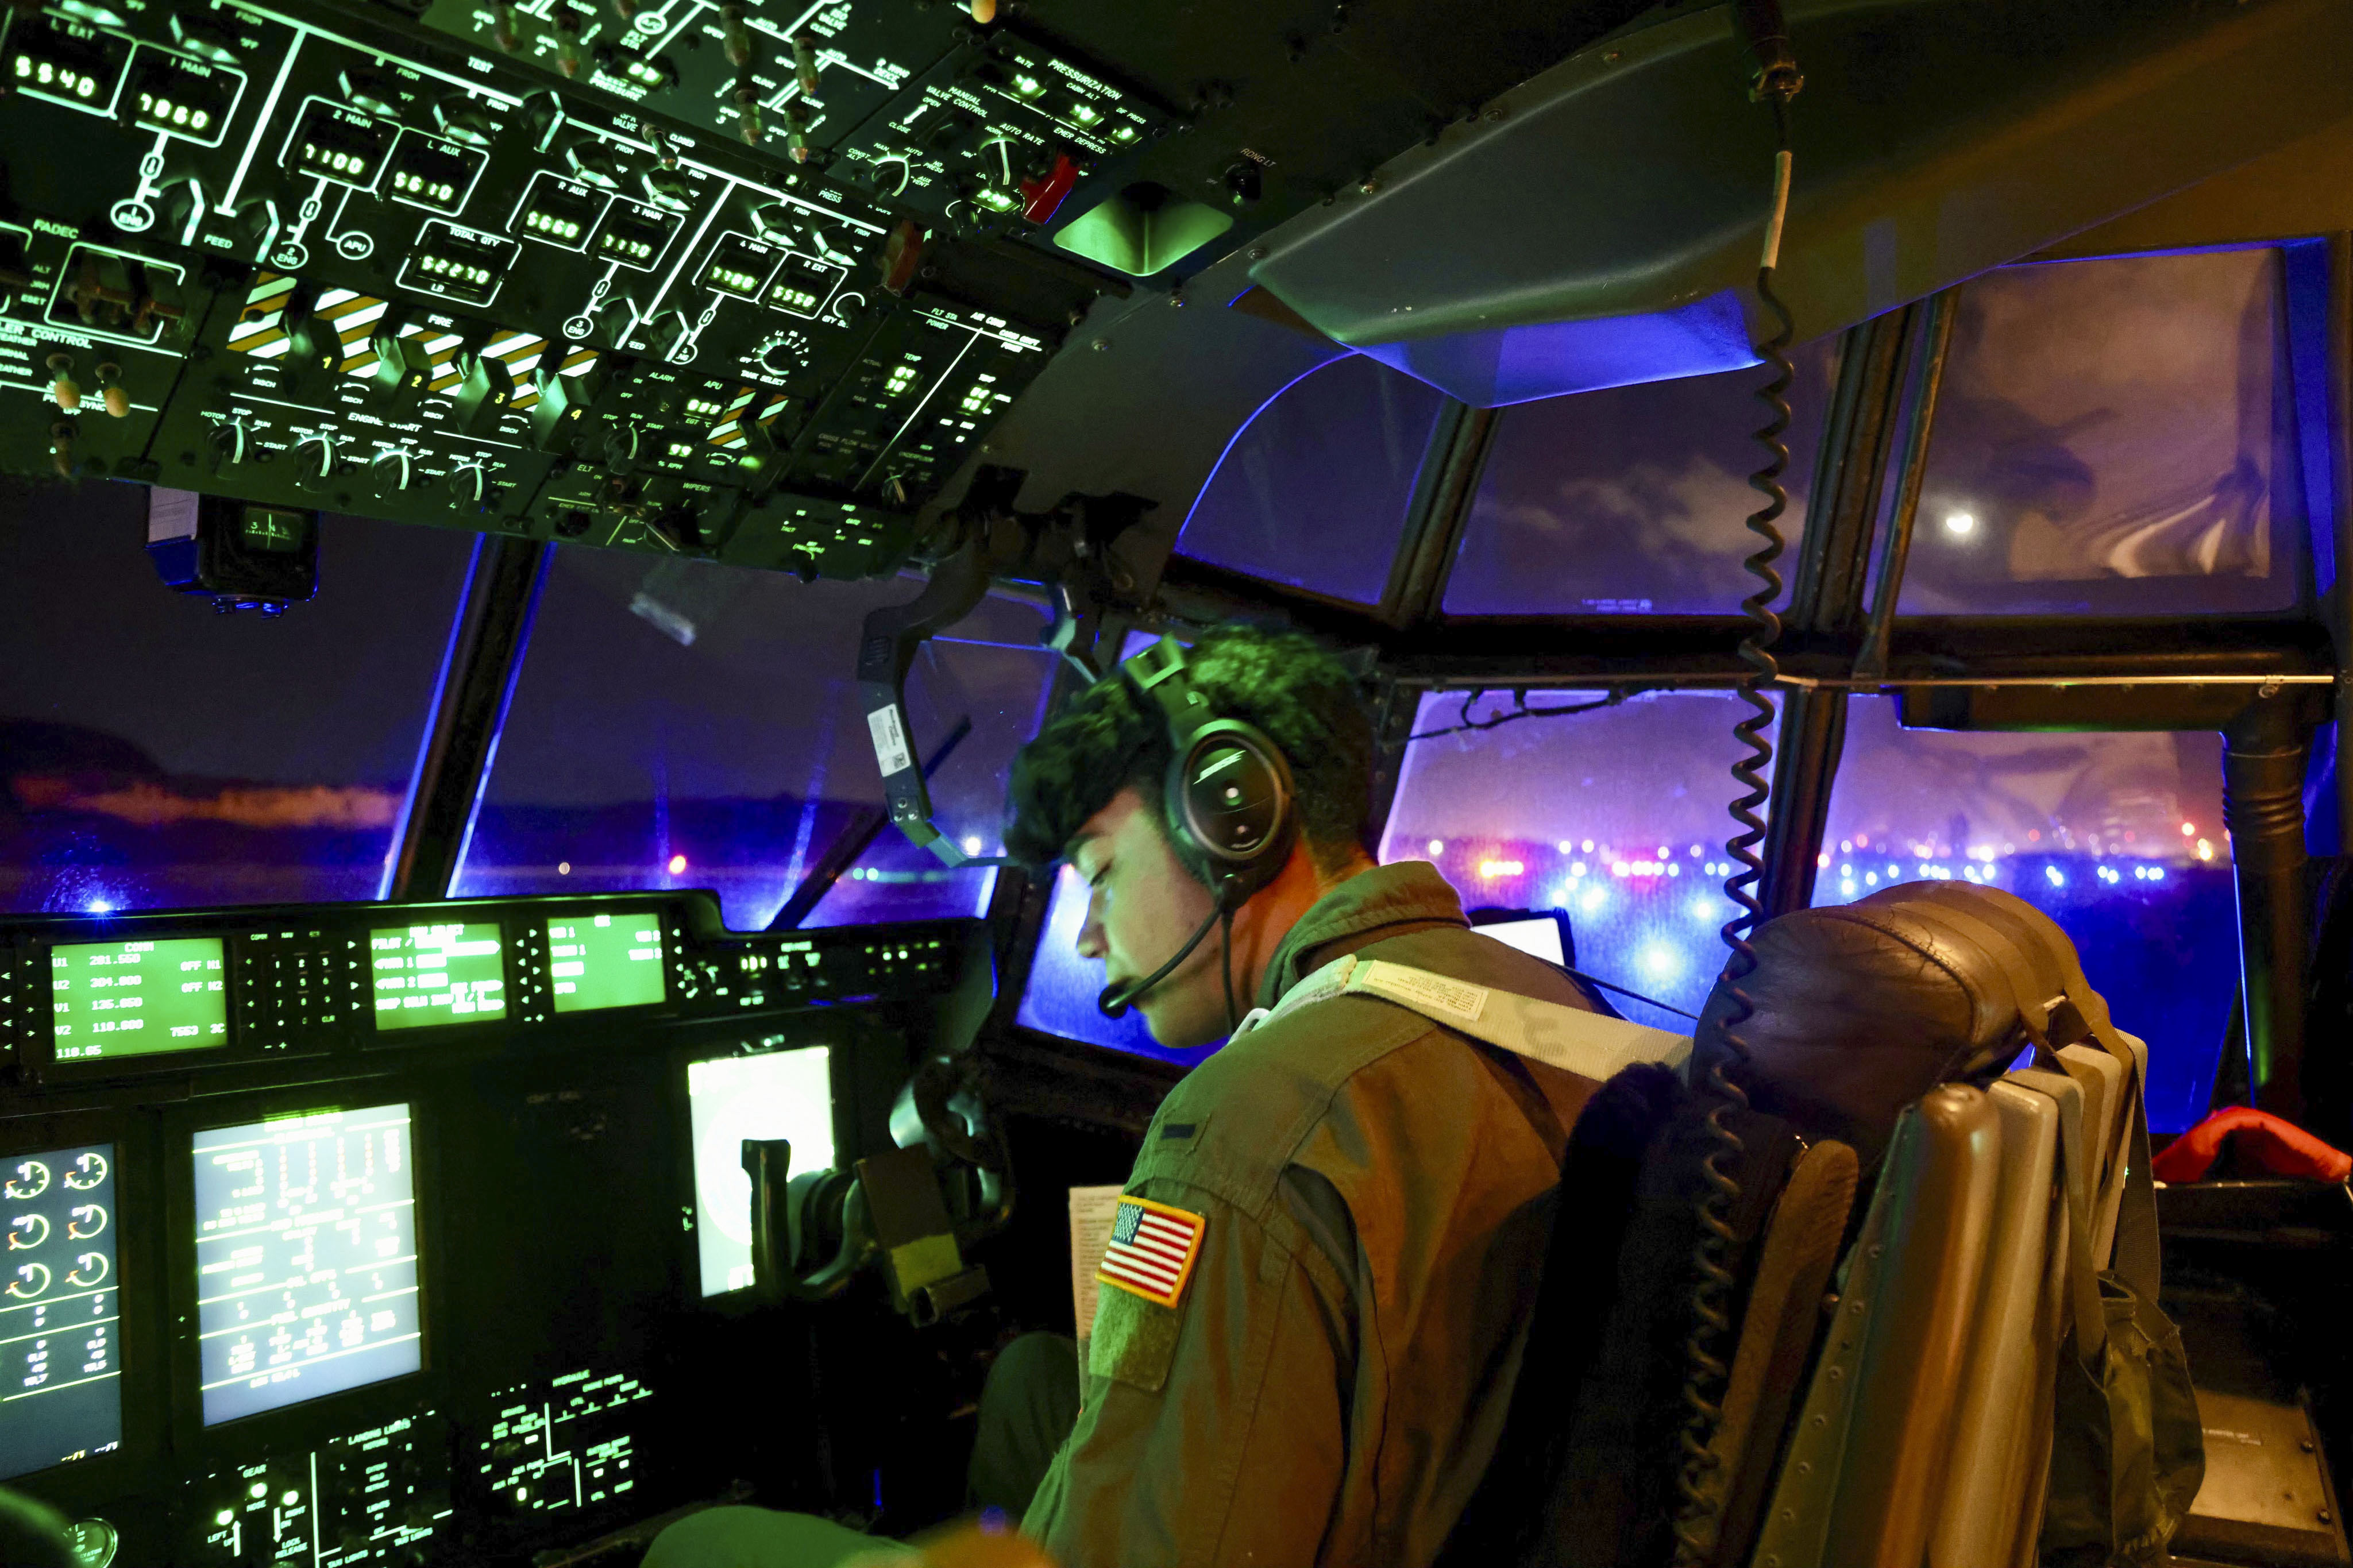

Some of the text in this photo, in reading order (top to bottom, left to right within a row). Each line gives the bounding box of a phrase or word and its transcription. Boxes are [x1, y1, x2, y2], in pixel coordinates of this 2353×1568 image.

[468, 56, 493, 73] TEST
[1015, 56, 1034, 68] RATE
[181, 60, 211, 78] MAIN
[396, 68, 420, 82] FROM
[1048, 59, 1123, 101] PRESSURIZATION
[948, 86, 981, 106] MANUAL
[1066, 82, 1101, 101] CABIN ALT
[487, 99, 510, 112] FROM
[923, 96, 942, 108] OPEN
[926, 85, 988, 118] VALVE CONTROL
[333, 110, 372, 129] 2 MAIN
[612, 117, 638, 132] VALVE
[1127, 113, 1147, 125] PRESS
[889, 121, 911, 134] CLOSE
[985, 126, 1003, 136] NORM
[999, 123, 1046, 146] AUTO RATE
[669, 134, 695, 148] CLOSED
[1054, 128, 1075, 140] EMER
[1074, 137, 1106, 154] DEPRESS
[427, 140, 461, 157] L AUX
[615, 144, 635, 155] FROM
[873, 142, 890, 152] MAN
[904, 146, 923, 156] AUTO
[848, 148, 871, 159] CONST
[1241, 148, 1265, 163] RDNG
[923, 162, 944, 173] PRESS
[688, 171, 707, 181] FROM
[917, 176, 932, 184] AUX
[912, 178, 930, 188] VENT
[558, 181, 588, 198] R AUX
[818, 190, 843, 203] PRESS
[642, 209, 664, 221] MAIN
[793, 207, 811, 217] FROM
[33, 219, 79, 240] FADEC
[854, 228, 871, 238] FROM
[203, 234, 233, 249] FEED
[450, 227, 500, 248] TOTAL QTY
[344, 240, 367, 252] APU
[748, 242, 768, 254] MAIN
[277, 254, 298, 265] ENG
[804, 260, 828, 273] R EXT
[431, 284, 445, 293] LB
[931, 308, 958, 321] FLT STA
[427, 314, 454, 328] FIRE
[926, 319, 949, 330] POWER
[568, 326, 585, 337] ENG
[32, 329, 92, 349] CONTROL
[322, 356, 333, 369] 1
[252, 377, 276, 388] DISCH
[411, 375, 423, 387] 2
[649, 371, 675, 383] ALARM
[759, 375, 786, 387] SELECT
[703, 380, 724, 391] APU
[341, 395, 364, 405] DISCH
[495, 392, 506, 404] 3
[200, 411, 227, 422] MOTOR
[232, 407, 253, 417] STOP
[423, 411, 445, 420] DISCH
[570, 409, 583, 421] 4
[253, 420, 272, 428] RUN
[319, 423, 339, 431] STOP
[645, 422, 665, 431] START
[289, 426, 315, 435] MOTOR
[499, 426, 519, 435] DISCH
[339, 434, 356, 443] RUN
[400, 438, 418, 446] STOP
[263, 441, 288, 451] START
[372, 441, 396, 450] MOTOR
[418, 448, 434, 457] RUN
[475, 451, 492, 459] STOP
[347, 455, 371, 465] START
[449, 454, 471, 463] MOTOR
[492, 462, 507, 470] RUN
[576, 464, 594, 473] ELT
[668, 462, 684, 470] RPM
[423, 468, 446, 477] START
[497, 480, 517, 489] START
[683, 482, 711, 493] WIPERS
[250, 521, 258, 529] 3
[348, 1428, 382, 1446] LANDING
[243, 1464, 267, 1478] GEAR
[207, 1530, 227, 1544] LEFT
[275, 1542, 308, 1560] RELEASE
